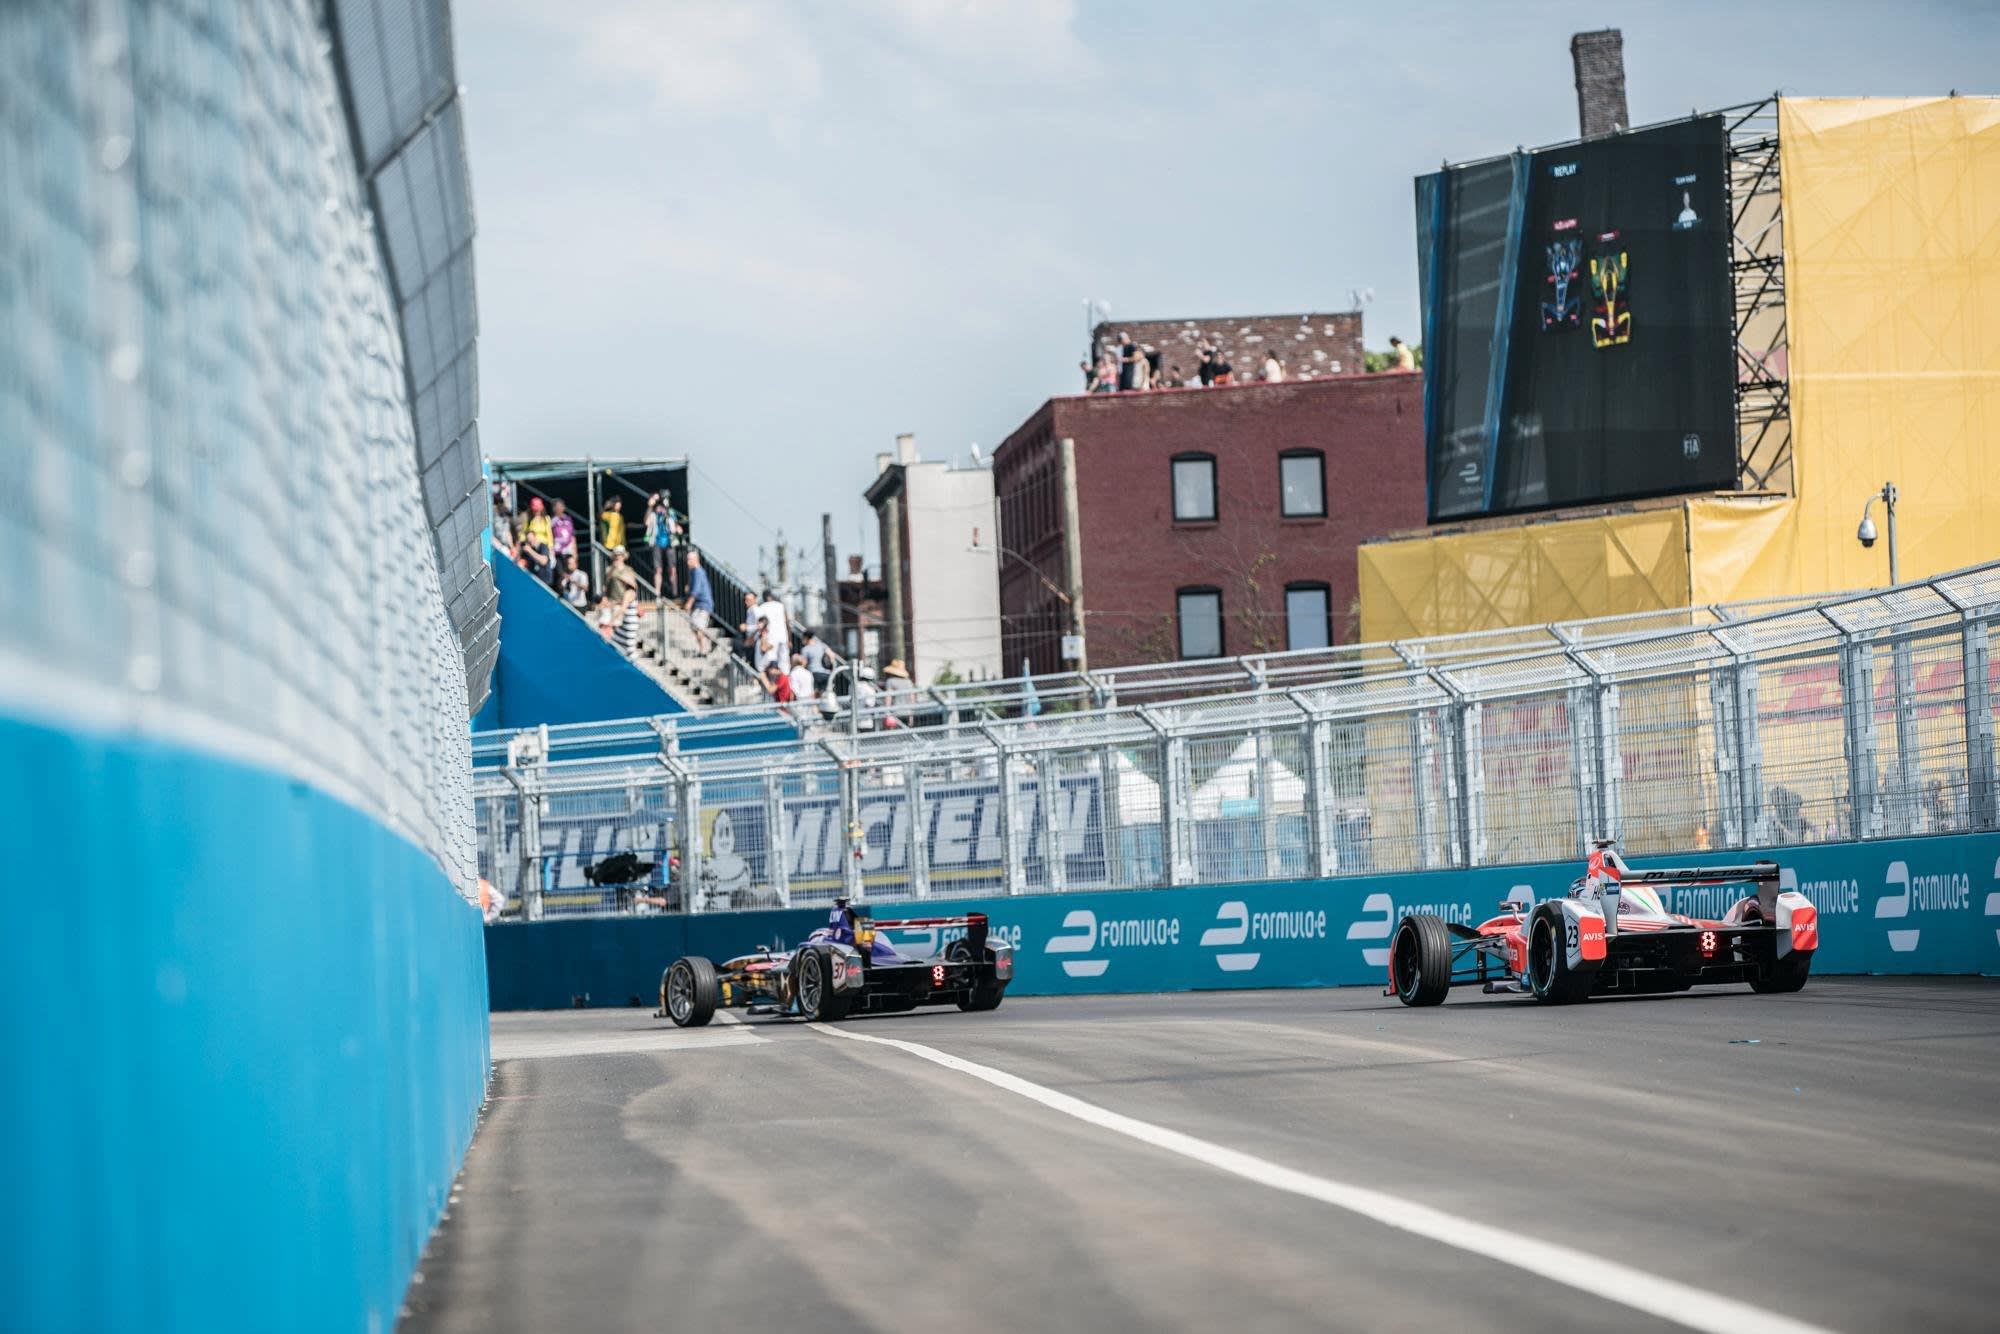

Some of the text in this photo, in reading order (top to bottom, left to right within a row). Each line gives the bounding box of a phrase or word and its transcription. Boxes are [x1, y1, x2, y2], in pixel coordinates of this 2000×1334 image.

[1683, 438, 1700, 456] FIA
[1794, 922, 1815, 932] AVIS
[1566, 925, 1579, 948] 23
[1583, 932, 1604, 941] AVIS
[832, 962, 845, 980] 37
